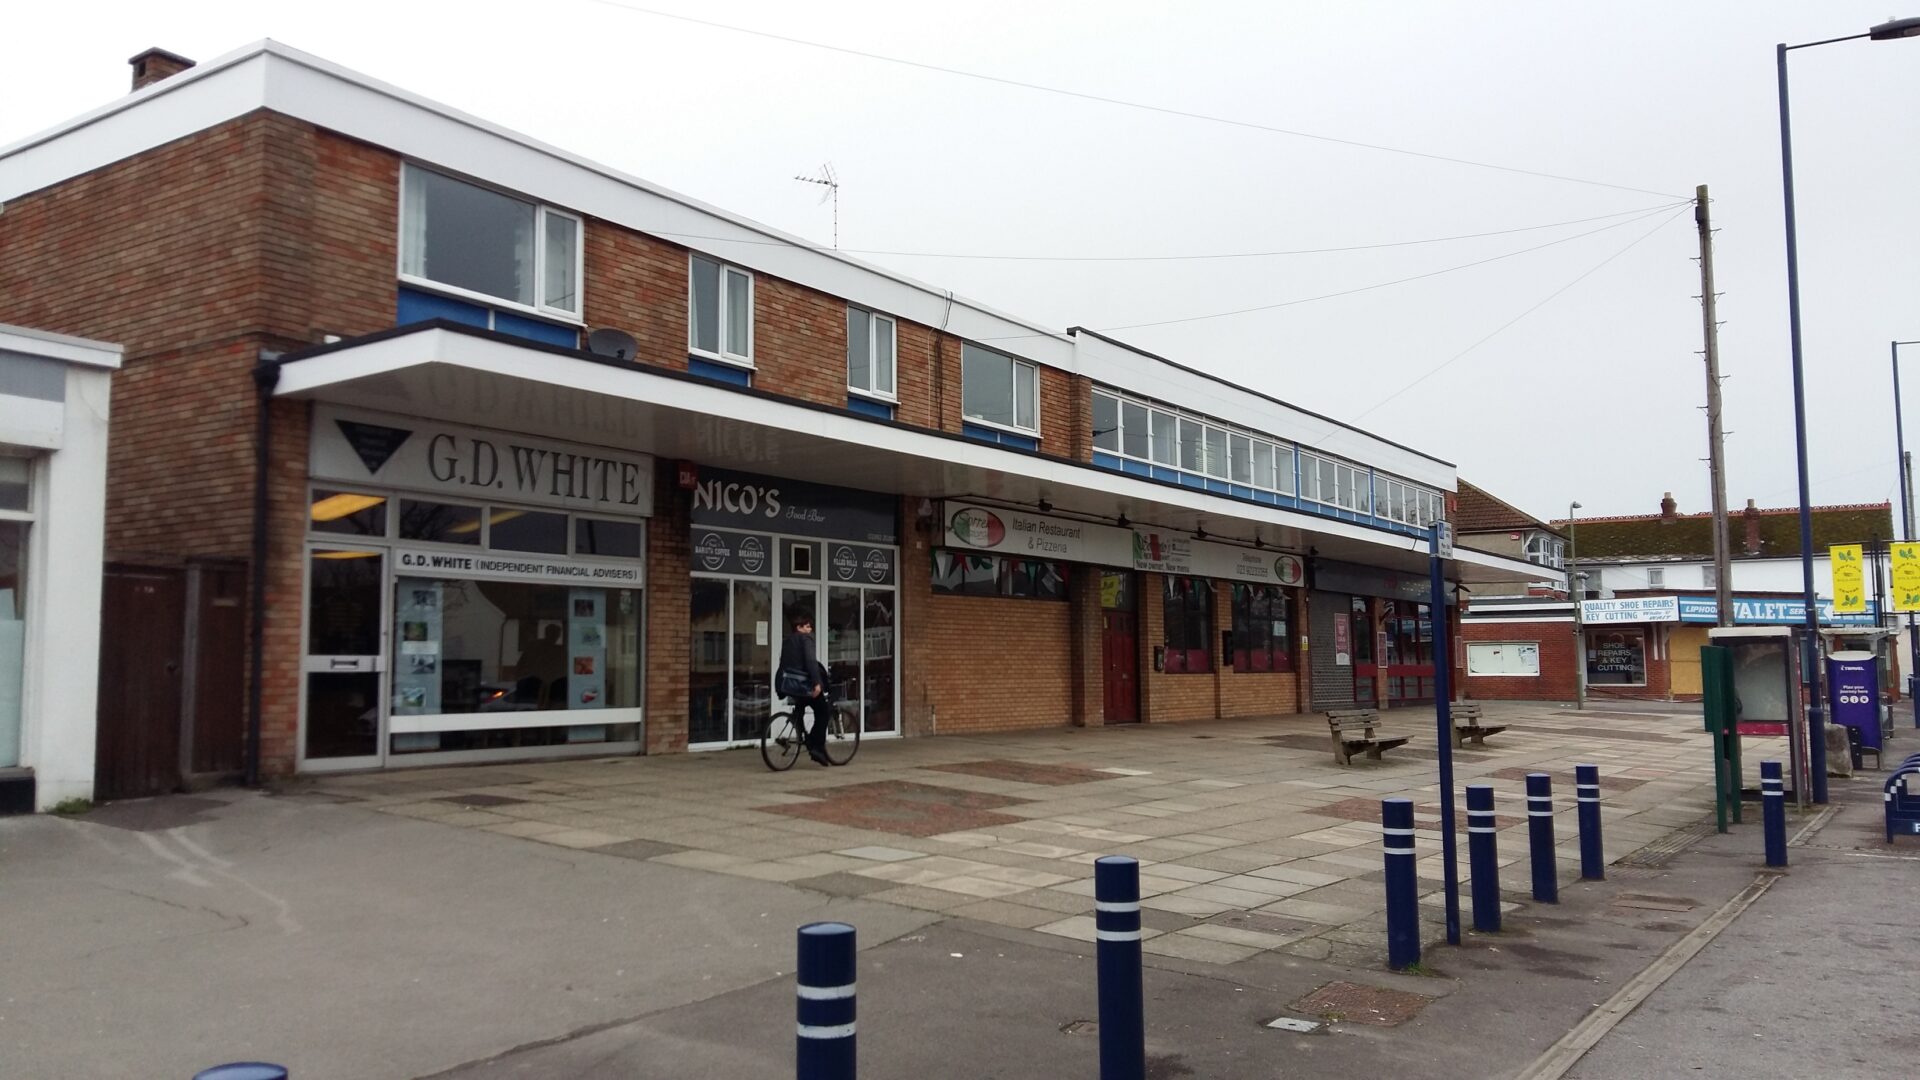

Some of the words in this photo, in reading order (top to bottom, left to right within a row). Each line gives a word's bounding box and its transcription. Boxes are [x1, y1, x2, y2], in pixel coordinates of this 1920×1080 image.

[693, 479, 781, 518] NICO'S
[1012, 517, 1037, 533] Italian
[1039, 521, 1081, 539] Restaurant
[1027, 537, 1034, 549] &
[1036, 538, 1068, 553] Pizzeria
[546, 565, 590, 577] FINANCIAL
[1584, 602, 1616, 613] QUALITY
[1620, 601, 1640, 609] SHOE
[1642, 599, 1674, 609] REPAIRS
[1686, 605, 1717, 614] LIPHOO
[1586, 613, 1600, 621] KEY
[1605, 611, 1638, 620] CUTTING
[1597, 649, 1631, 657] REPAIRS
[1610, 656, 1627, 664] KEY
